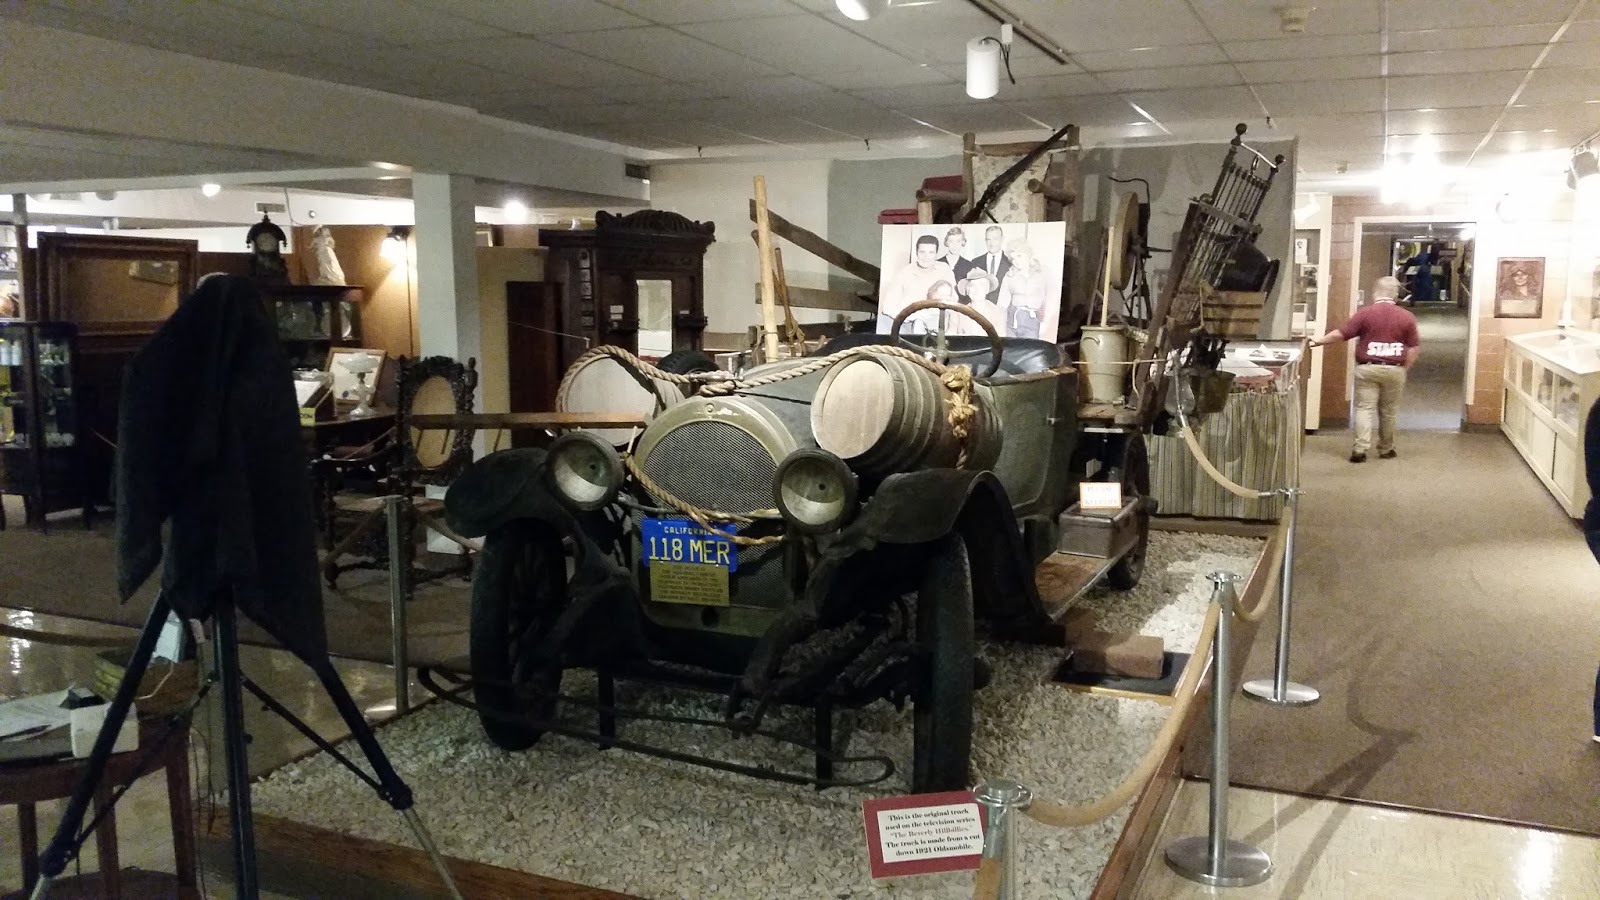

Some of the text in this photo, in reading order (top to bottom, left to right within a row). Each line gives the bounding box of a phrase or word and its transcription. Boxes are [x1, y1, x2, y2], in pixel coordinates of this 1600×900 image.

[1366, 341, 1404, 357] STAFF
[649, 536, 730, 564] 118 MER
[888, 814, 904, 822] This
[924, 810, 950, 818] original
[885, 823, 901, 831] used
[956, 816, 976, 824] series
[908, 828, 933, 838] Beverly
[900, 839, 920, 847] truck
[927, 836, 946, 844] made
[915, 847, 932, 855] 1921
[934, 845, 974, 853] Oldsmobile.
